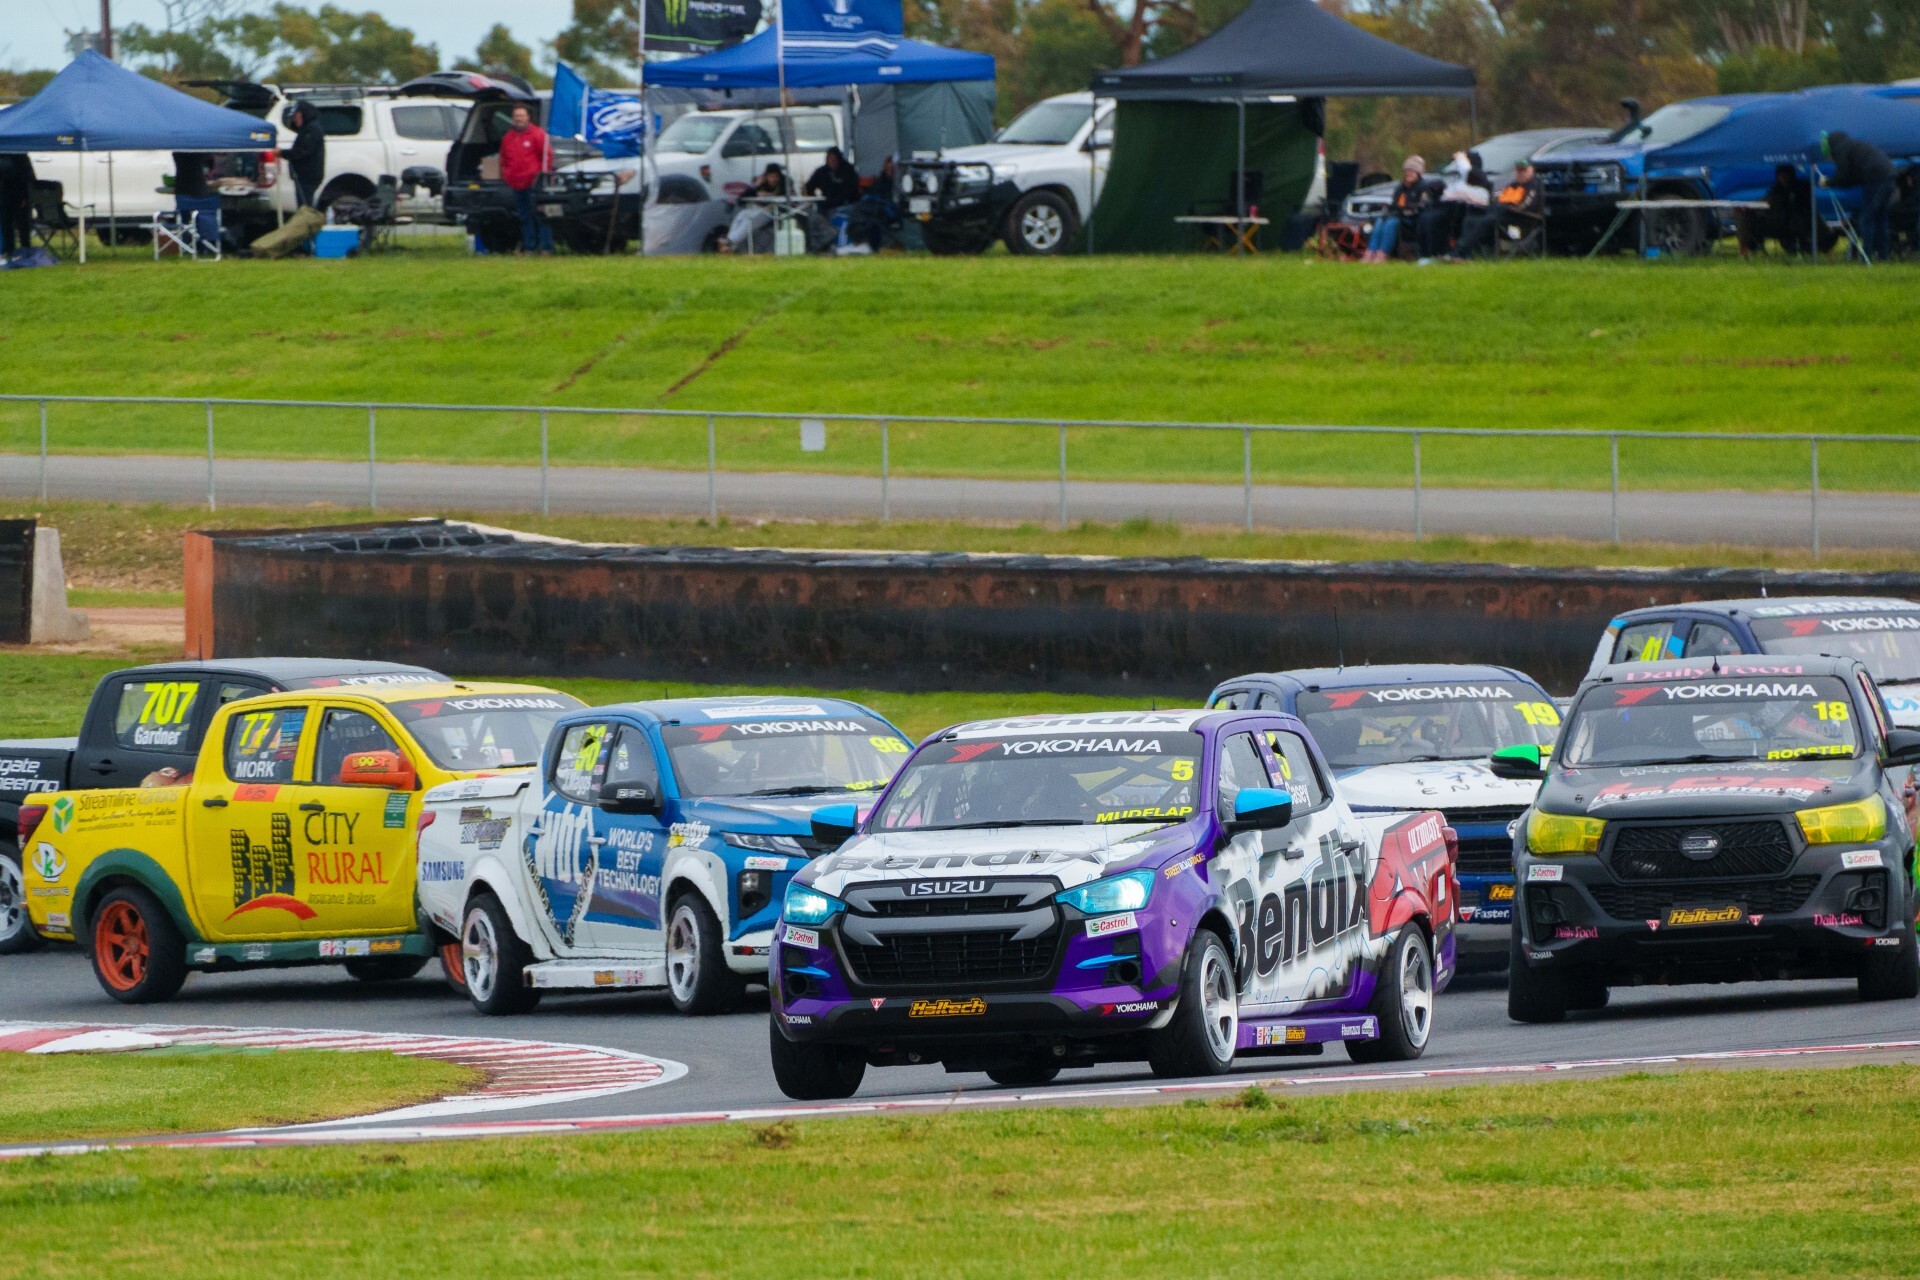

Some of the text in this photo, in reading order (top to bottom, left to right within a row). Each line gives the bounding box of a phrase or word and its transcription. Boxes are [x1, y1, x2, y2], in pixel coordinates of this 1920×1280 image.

[1626, 664, 1803, 681] Daily Food
[1367, 686, 1514, 703] YOKOHAMA
[1663, 683, 1818, 700] YOKOHAMA
[138, 681, 199, 725] 707
[446, 698, 565, 711] YOKOHAMA
[1812, 701, 1849, 721] 18
[1512, 701, 1562, 726] 19
[239, 712, 276, 747] 77
[731, 720, 868, 735] YOKOHAMA
[959, 714, 1187, 732] Bendix
[134, 726, 182, 745] Gardner
[868, 736, 909, 753] 96
[1001, 738, 1163, 756] YOKOHAMA
[1767, 744, 1855, 761] ROOSTER
[0, 757, 41, 776] gate
[235, 760, 276, 778] MORK
[1170, 760, 1195, 781] 5
[1666, 786, 1725, 796] DRIVE
[78, 790, 137, 811] Streamline
[1095, 806, 1194, 823] MUDFLAP
[304, 811, 361, 845] CITY
[1407, 815, 1443, 855] ULTIMATE
[607, 827, 655, 851] WORLD'S
[616, 850, 642, 871] BEST
[756, 859, 781, 867] Castrol
[1852, 854, 1876, 864] Castrol
[306, 851, 390, 886] RURAL
[422, 860, 465, 882] SAMSUNG
[1536, 867, 1557, 878] Castrol
[597, 868, 662, 897] TECHNOLOGY
[910, 880, 986, 895] ISUZU
[347, 892, 377, 905] Brokers
[1226, 828, 1368, 996] Bendix
[1668, 905, 1743, 926] Haltech
[1100, 916, 1130, 932] Castrol
[793, 932, 814, 945] Castrol
[909, 997, 988, 1018] Haltech
[1115, 1000, 1159, 1014] YOKOHAMA
